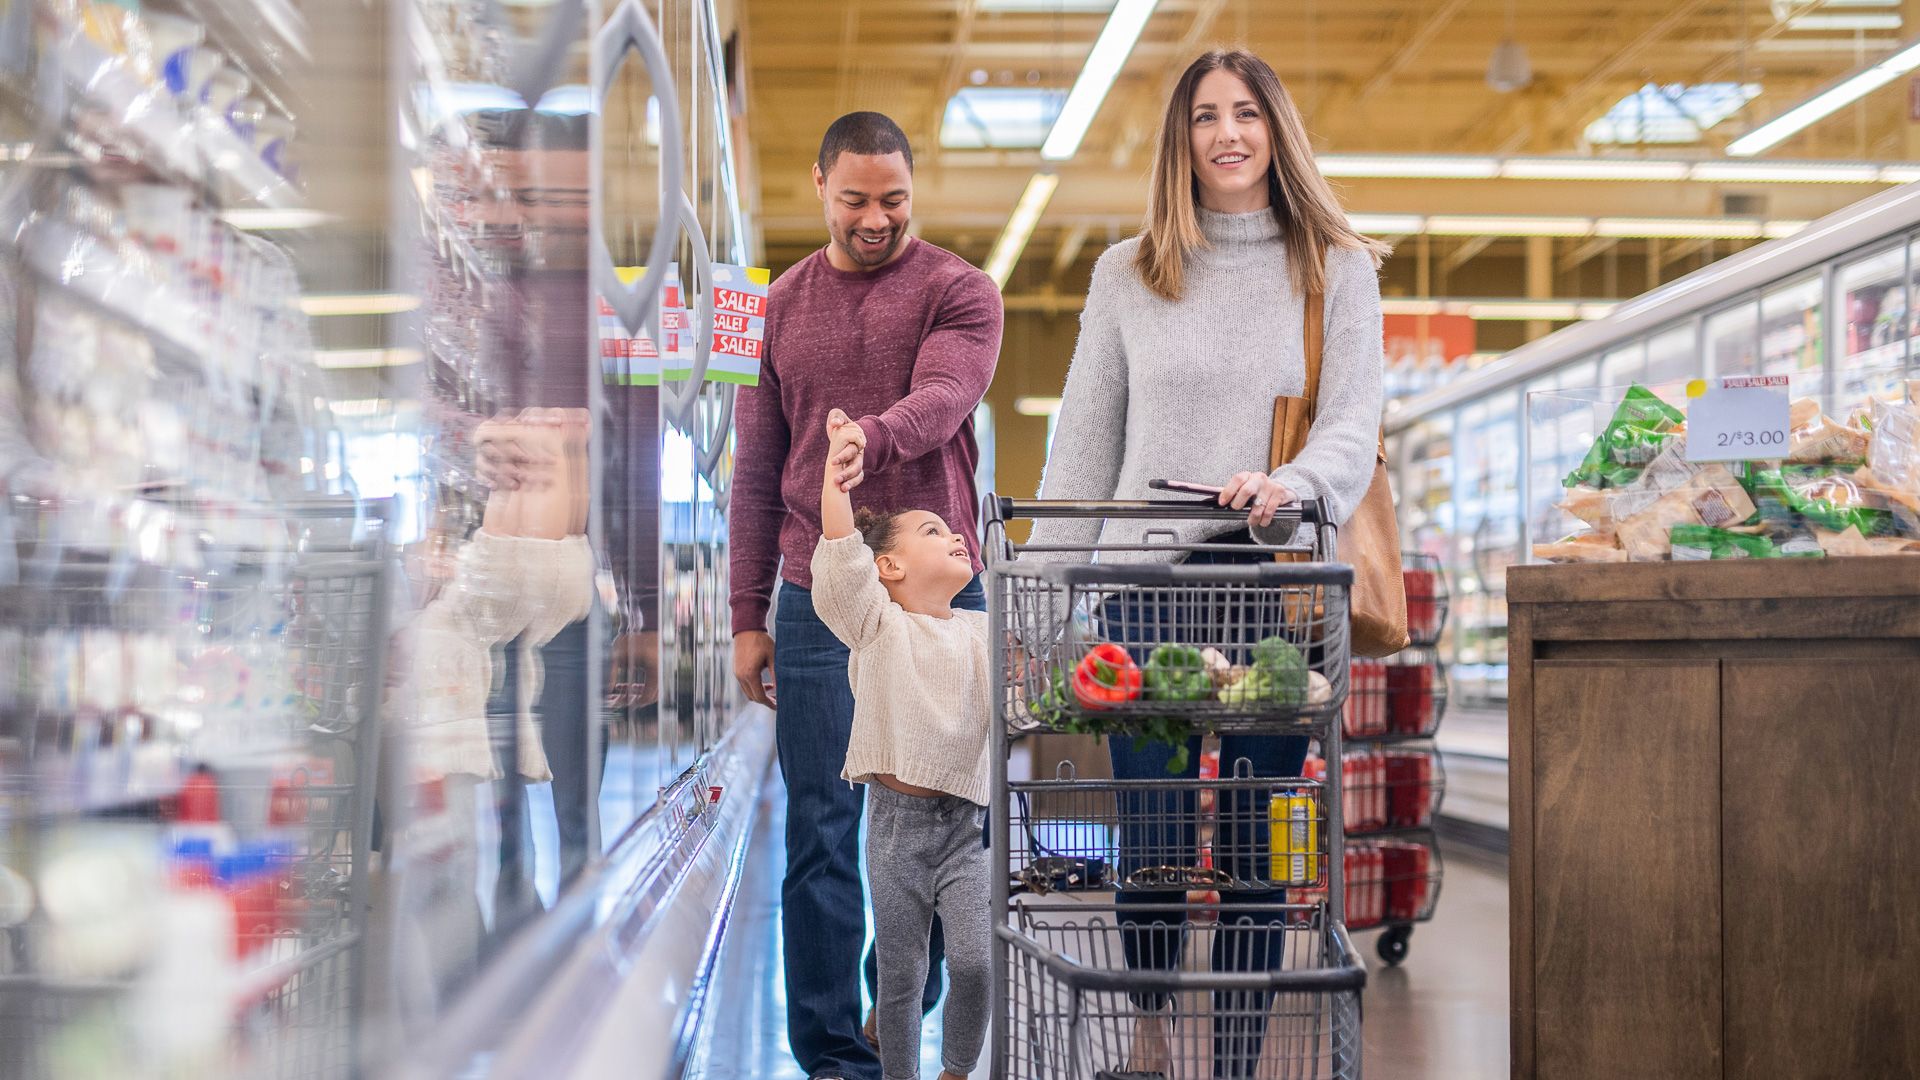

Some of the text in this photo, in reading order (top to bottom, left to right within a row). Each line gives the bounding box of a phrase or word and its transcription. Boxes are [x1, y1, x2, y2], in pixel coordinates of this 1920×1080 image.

[717, 290, 760, 314] SALE!
[719, 335, 758, 356] SALE!
[1767, 376, 1787, 386] SALE!
[1717, 430, 1784, 447] 2/$3.00
